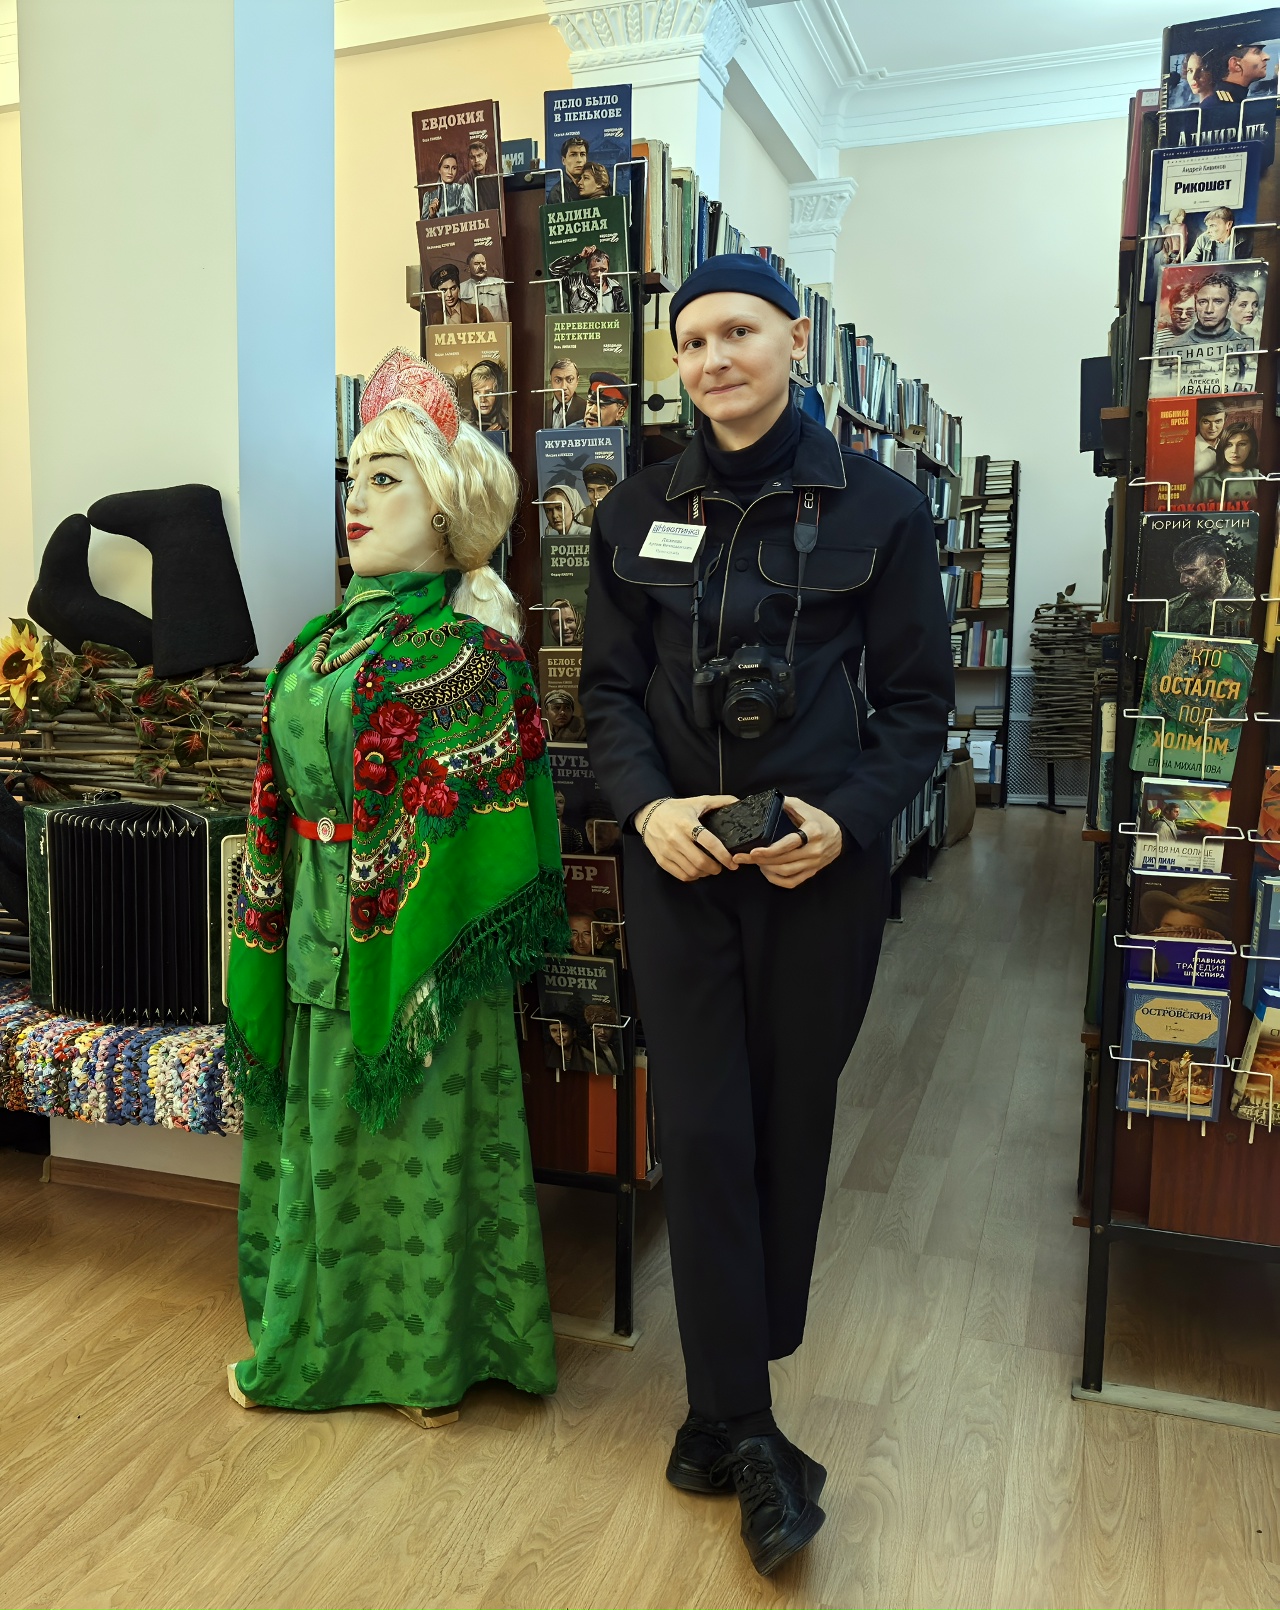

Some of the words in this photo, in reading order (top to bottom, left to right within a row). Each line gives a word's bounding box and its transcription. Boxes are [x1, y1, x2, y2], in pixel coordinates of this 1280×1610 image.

[554, 98, 582, 111] ДЕЛО
[585, 94, 619, 107] БЫЛО
[421, 110, 485, 131] ЕВДОКИЯ
[554, 113, 561, 123] В
[564, 108, 622, 122] ПЕНЬКОВЕ
[1174, 179, 1232, 195] Рикошет
[547, 206, 602, 224] КАЛИНА
[425, 218, 491, 238] ЖУРБИНЫ
[548, 218, 609, 237] КРАСНАЯ
[553, 319, 620, 332] ДЕРЕВЕНСКИЙ
[434, 330, 498, 346] МАЧЕХА
[553, 332, 601, 342] ДЕТЕКТИВ
[544, 437, 613, 449] ЖУРАВУШКА
[1151, 518, 1192, 530] ЮРИЙ
[1197, 518, 1250, 529] КОСТИН
[550, 544, 590, 557] РОДНА
[550, 557, 590, 567] КРОВЬ
[547, 658, 576, 666] БЕЛОЕ
[1191, 648, 1222, 668] КТО
[547, 667, 582, 678] ПУСТ
[1159, 675, 1241, 700] ОСТАЛСЯ
[1178, 705, 1213, 727] ПОД
[1152, 730, 1230, 755] ХОЛМОМ
[548, 754, 590, 768] ПУТЬ
[557, 768, 596, 779] ПРИЧА
[1170, 846, 1180, 854] НА
[562, 864, 598, 882] УБР
[543, 964, 608, 978] ТАЕЖНЫЙ
[544, 975, 598, 990] МОРЯК
[1141, 1007, 1213, 1021] ОСТРОВСКИЙ
